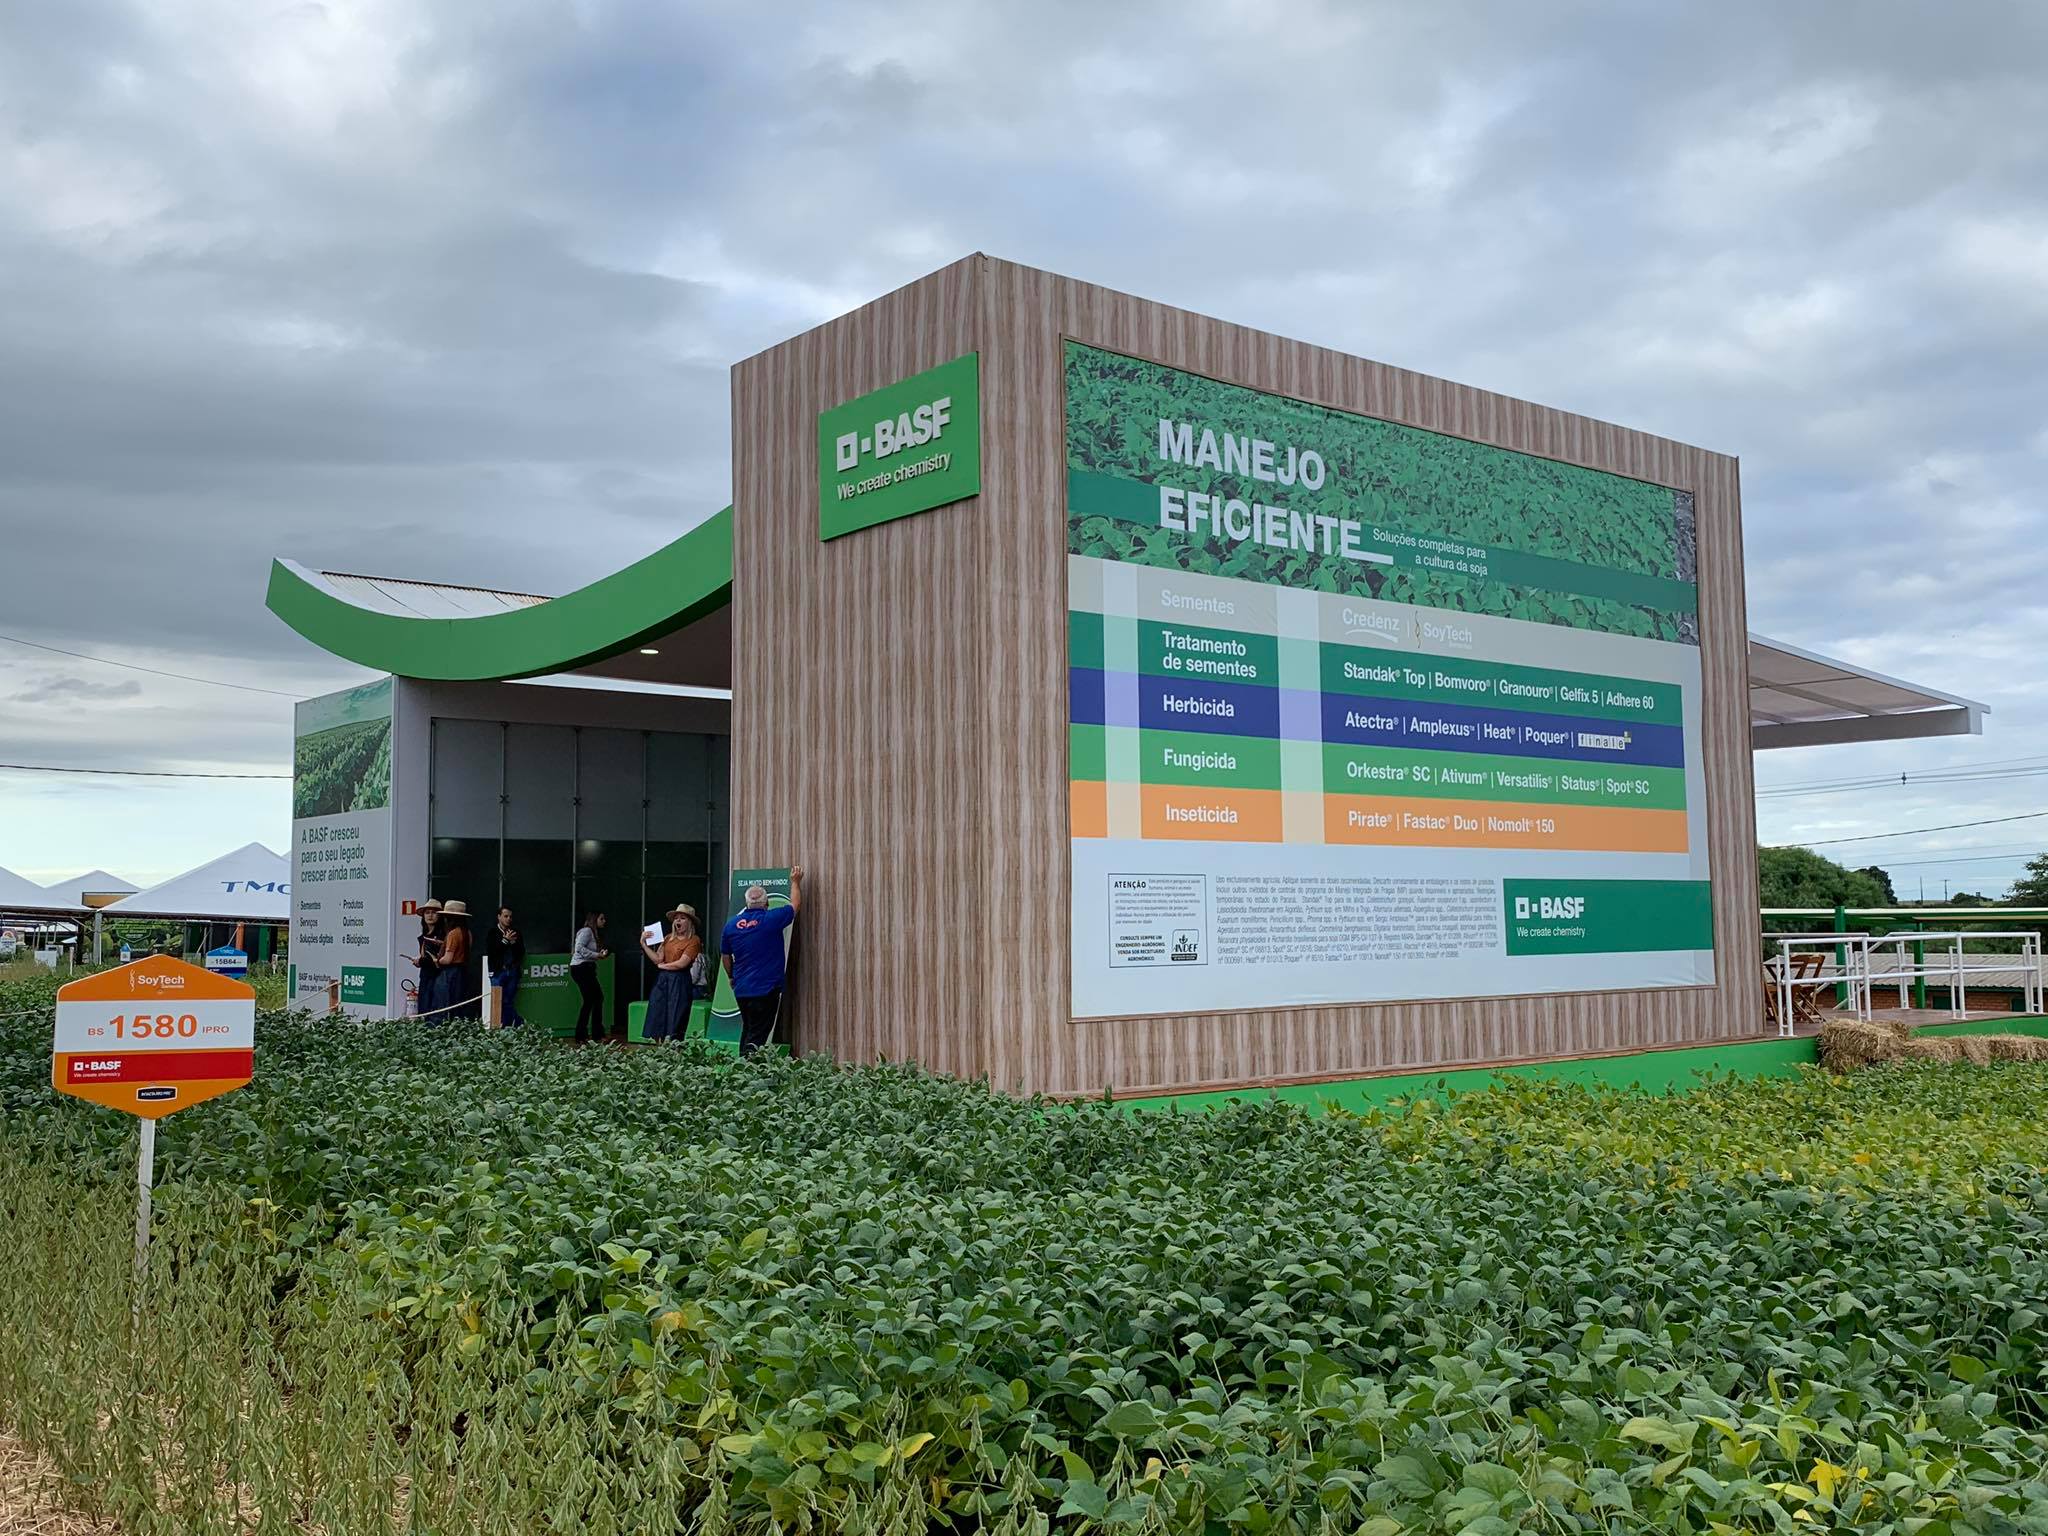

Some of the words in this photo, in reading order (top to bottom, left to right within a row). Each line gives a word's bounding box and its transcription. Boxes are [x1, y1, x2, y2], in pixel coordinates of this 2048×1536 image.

[875, 397, 951, 459] BASF
[1159, 419, 1325, 491] MANEJO
[837, 484, 855, 500] We
[857, 472, 891, 494] create
[894, 452, 952, 482] chemistry
[1160, 486, 1362, 558] EFICIENTE
[1373, 528, 1416, 547] Soluções
[1418, 536, 1466, 558] completas
[1466, 547, 1487, 561] para
[1415, 556, 1421, 565] a
[1423, 554, 1455, 572] cultura
[1456, 560, 1468, 573] da
[1469, 561, 1488, 577] soja
[1161, 590, 1235, 615] Sementes
[1343, 608, 1399, 631] Credenz
[1162, 630, 1246, 656] Tratamento
[1423, 621, 1473, 643] SoyTech
[1163, 654, 1181, 670] de
[1186, 657, 1257, 678] sementes
[1403, 668, 1425, 690] Top
[1560, 686, 1590, 703] Gelfix
[1591, 690, 1598, 703] 5
[1606, 691, 1641, 709] Adhere
[1642, 695, 1654, 710] 60
[1163, 694, 1235, 717] Herbicida
[1164, 748, 1236, 771] Fungicida
[1412, 766, 1430, 782] SC
[1635, 781, 1650, 795] SC
[1165, 803, 1238, 824] Inseticida
[1454, 815, 1478, 832] Duo
[1535, 818, 1554, 834] 150
[302, 829, 307, 844] A
[309, 827, 328, 844] BASF
[330, 827, 360, 841] cresceu
[301, 851, 317, 866] para
[319, 850, 324, 862] o
[325, 849, 338, 861] seu
[340, 844, 365, 863] legado
[301, 870, 327, 883] crescer
[328, 866, 348, 881] ainda
[1114, 880, 1146, 890] ATENÇÃO
[343, 899, 364, 910] Produtos
[1540, 897, 1584, 919] BASF
[1516, 927, 1529, 937] We
[1530, 927, 1552, 937] create
[1553, 926, 1585, 938] chemistry
[138, 975, 185, 986] SoyTech
[531, 964, 568, 978] BASF
[87, 1028, 104, 1036] BS
[109, 1015, 198, 1039] 1580
[202, 1025, 230, 1034] IPRO
[91, 1061, 121, 1070] BASF
